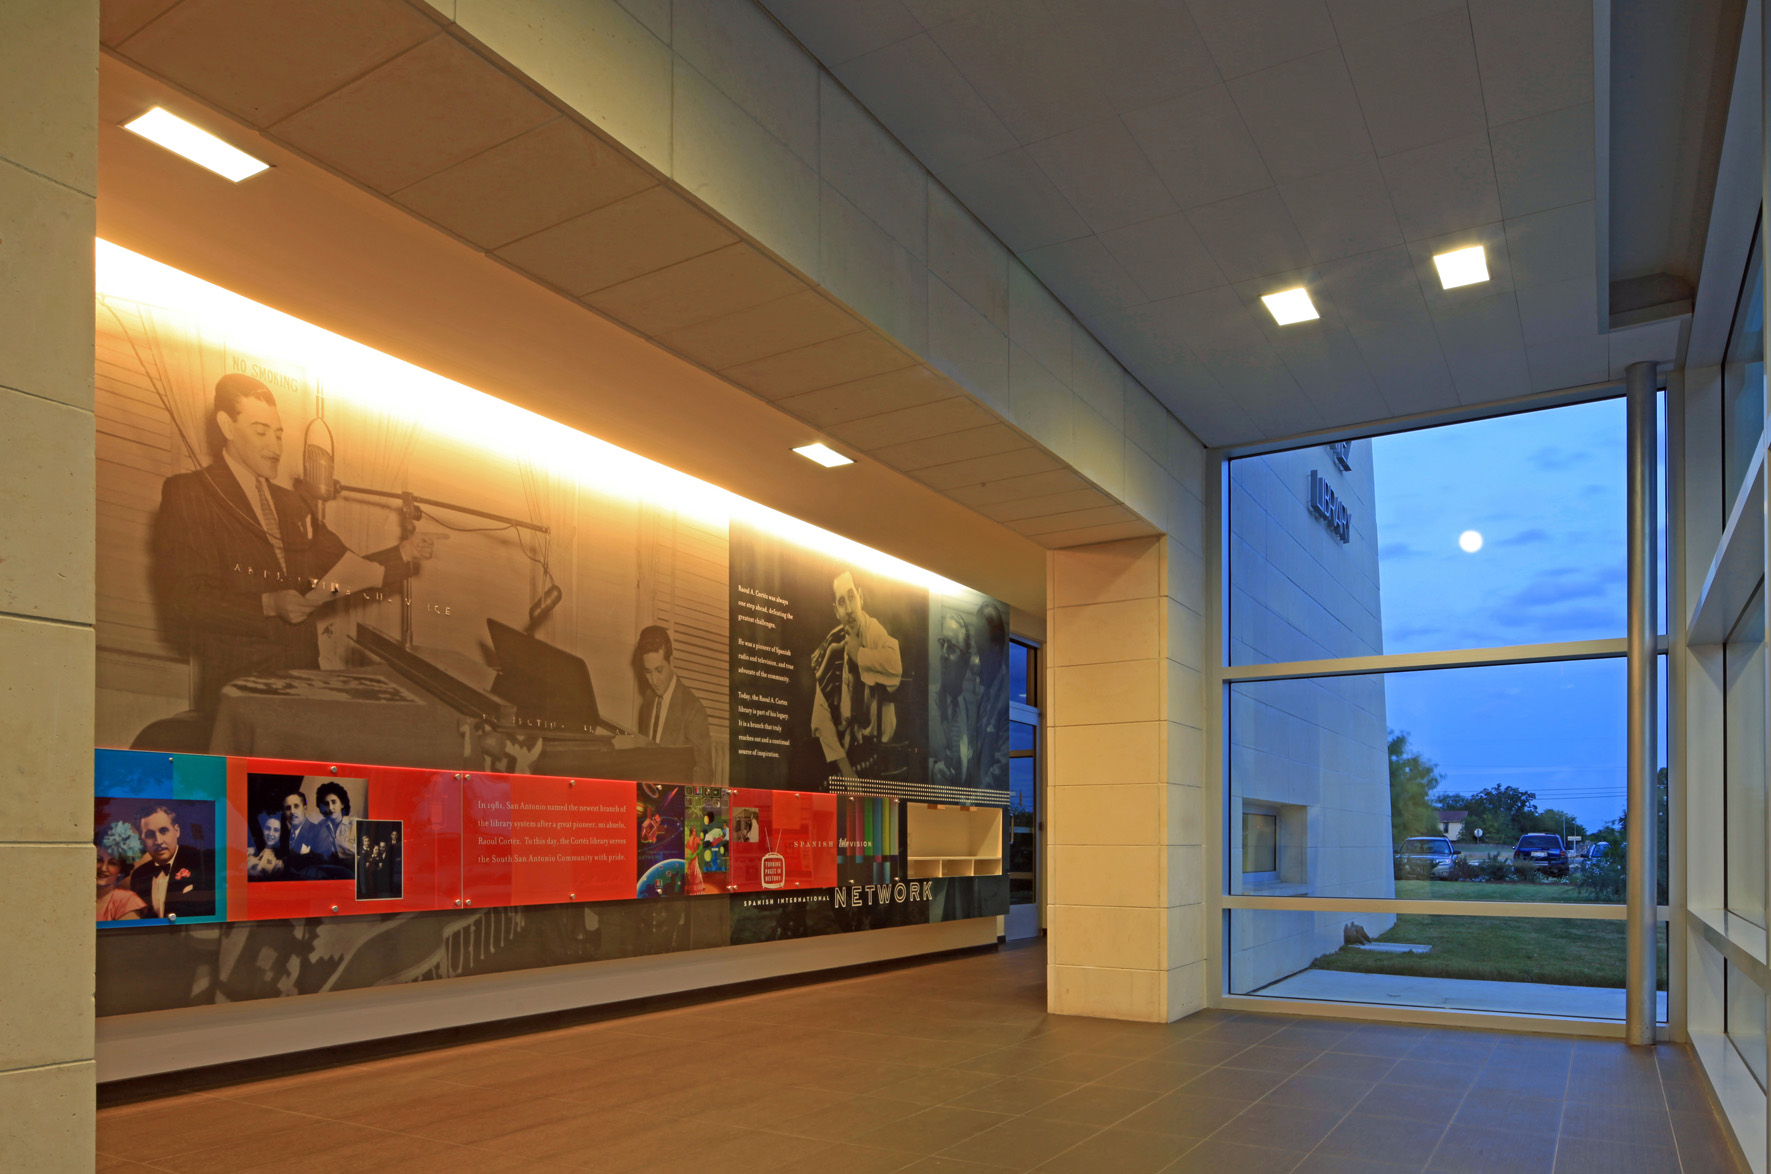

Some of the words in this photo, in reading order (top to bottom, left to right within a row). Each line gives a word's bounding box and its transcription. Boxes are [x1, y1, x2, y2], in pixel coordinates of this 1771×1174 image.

[232, 356, 247, 372] NO
[252, 364, 298, 392] SMOKING
[756, 643, 771, 651] pioneer
[776, 646, 791, 656] Spanish
[750, 721, 764, 729] branch
[773, 725, 782, 733] truly
[506, 801, 519, 809] San
[520, 802, 546, 810] Antonio
[490, 819, 512, 830] library
[514, 821, 536, 830] system
[557, 821, 572, 830] great
[590, 837, 608, 847] library
[492, 854, 512, 863] South
[514, 854, 527, 862] San
[557, 854, 593, 863] Community
[743, 898, 774, 907] SPANISH
[778, 895, 830, 904] INTERNATIONAL
[834, 881, 933, 909] NETWORK
